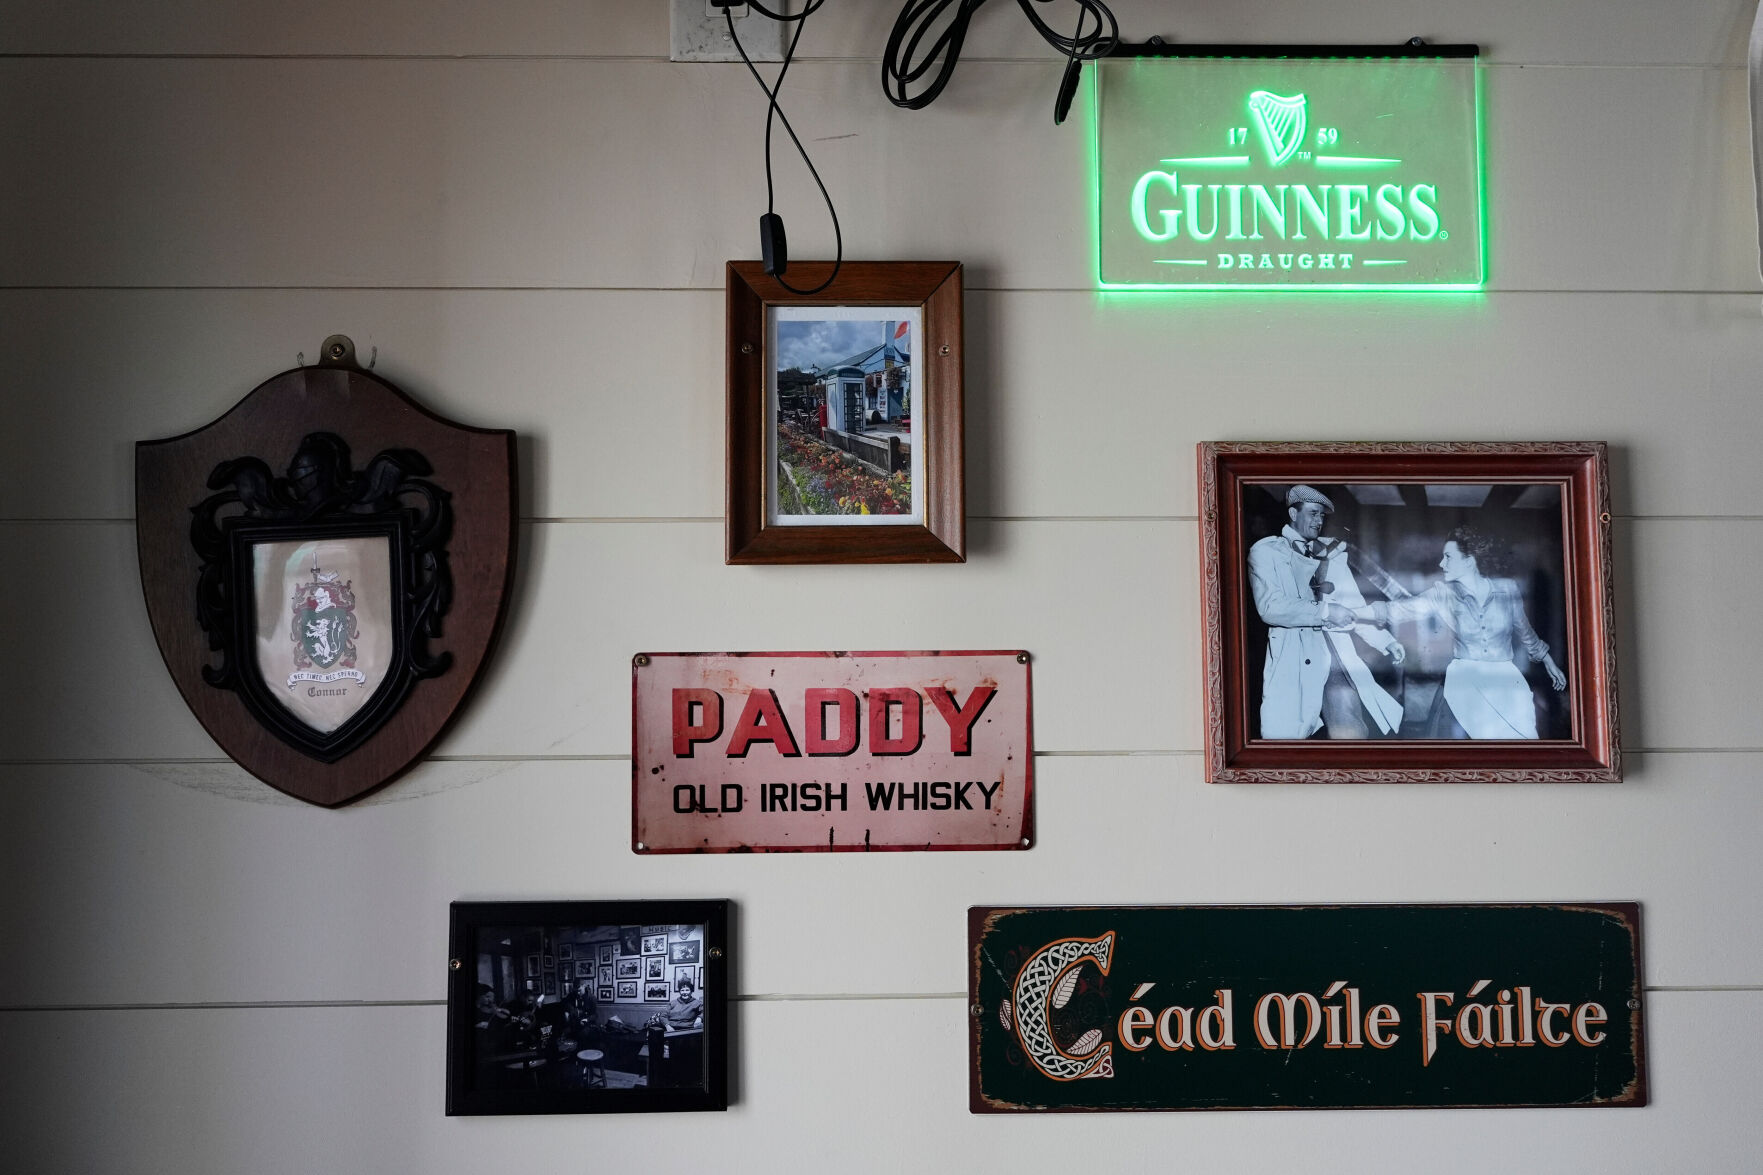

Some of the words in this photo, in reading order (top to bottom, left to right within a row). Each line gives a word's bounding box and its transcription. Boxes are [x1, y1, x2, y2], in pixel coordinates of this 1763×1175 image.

[1228, 127, 1248, 145] 17
[1317, 127, 1339, 145] 59
[1131, 170, 1439, 242] GUINNESS
[1217, 253, 1353, 269] DRAUGHT
[307, 687, 347, 697] Connor
[672, 687, 998, 759] PADDY
[673, 783, 743, 814] OLD
[760, 782, 848, 812] IRISH
[864, 781, 1002, 811] WHISKY
[1012, 930, 1237, 1081] Céad
[1253, 980, 1401, 1050] Míle
[1416, 979, 1608, 1068] Fáilte
